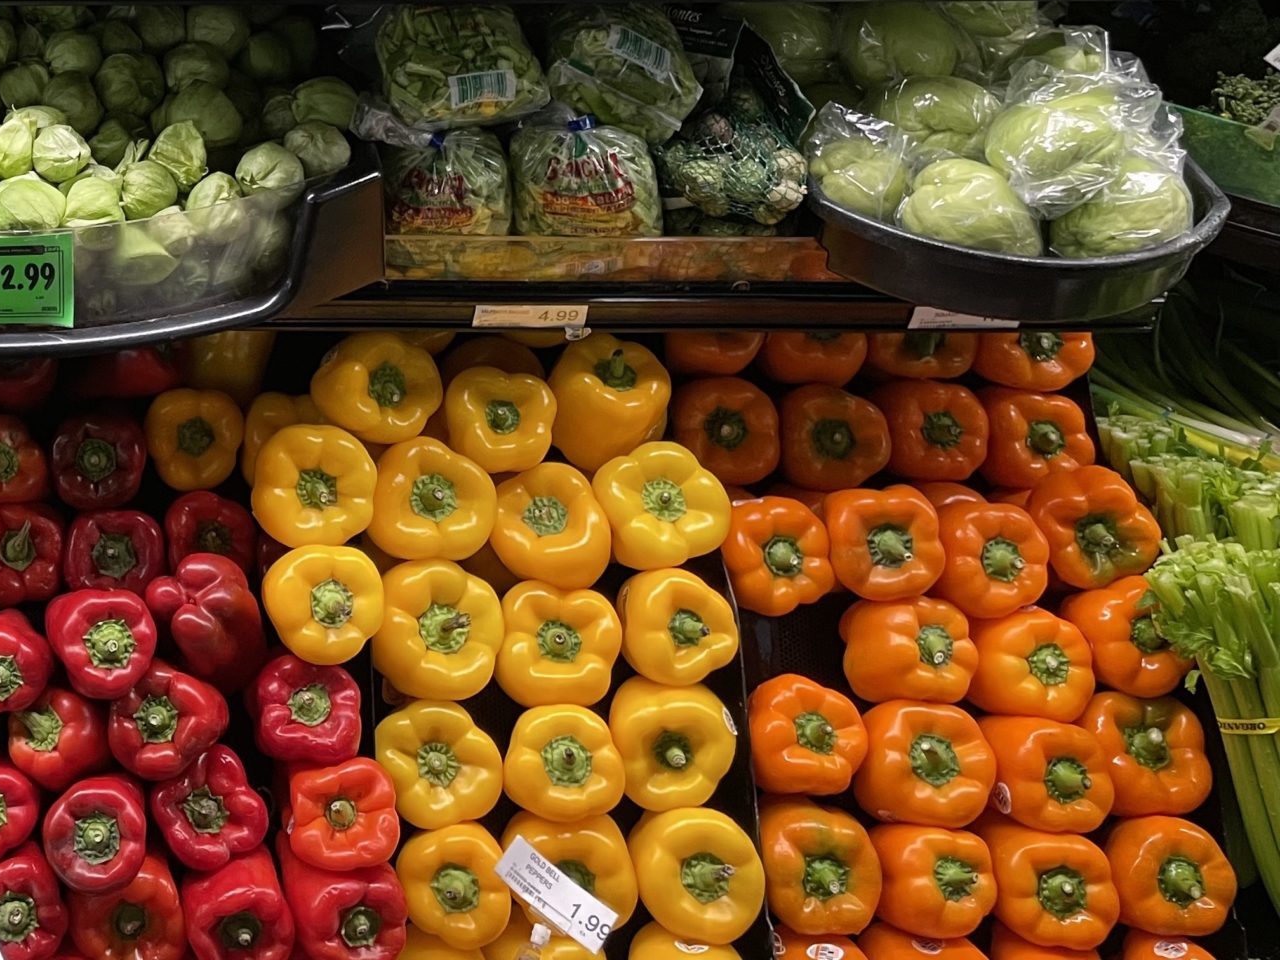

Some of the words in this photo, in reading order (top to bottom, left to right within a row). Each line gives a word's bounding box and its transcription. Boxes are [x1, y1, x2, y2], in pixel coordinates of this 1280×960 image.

[538, 310, 579, 321] 4.99
[1217, 721, 1266, 731] ORGANIC
[525, 864, 553, 890] PEPPERS
[530, 852, 546, 870] GOLD
[545, 866, 561, 883] BELL
[570, 903, 612, 941] 1.99
